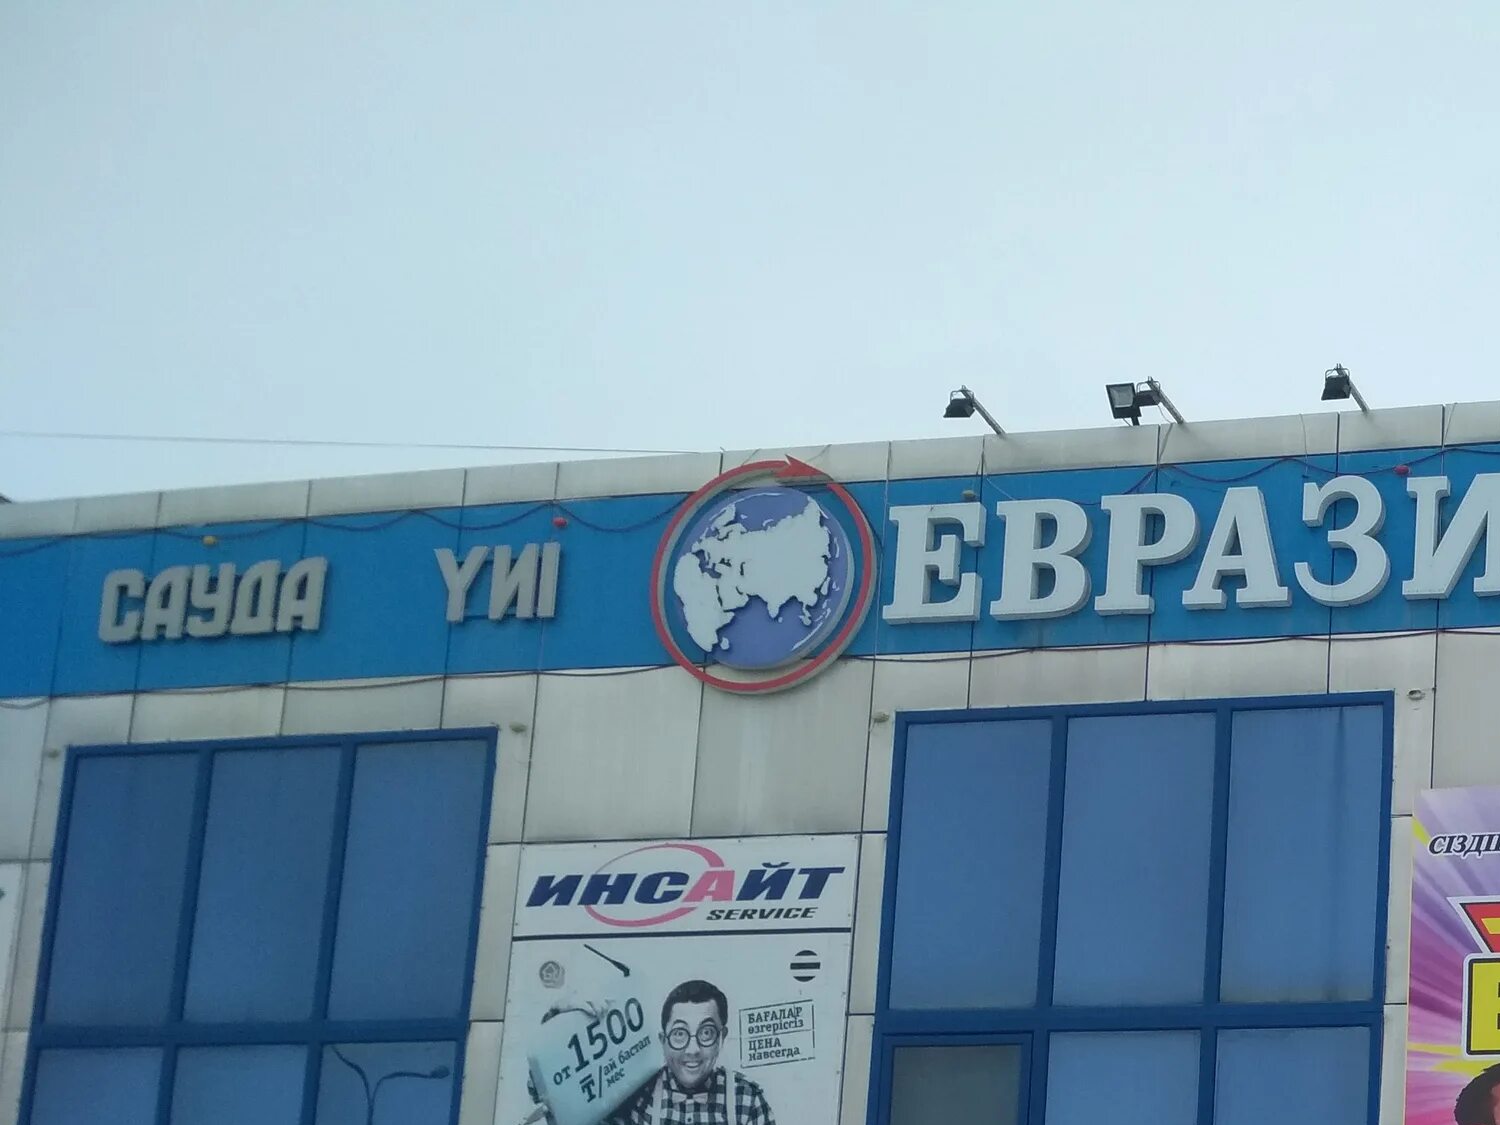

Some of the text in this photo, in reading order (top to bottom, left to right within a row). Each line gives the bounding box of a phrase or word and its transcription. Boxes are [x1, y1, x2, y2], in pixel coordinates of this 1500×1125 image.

[98, 556, 328, 643] САУДА
[526, 861, 845, 908] ИНСАЙТ
[706, 906, 819, 921] SERVICE
[747, 1006, 803, 1025] БАҒАЛАР
[553, 997, 645, 1086] от 1500
[618, 1034, 652, 1064] бастап
[748, 1037, 782, 1053] ЦЕНА
[748, 1046, 801, 1062] навсегда
